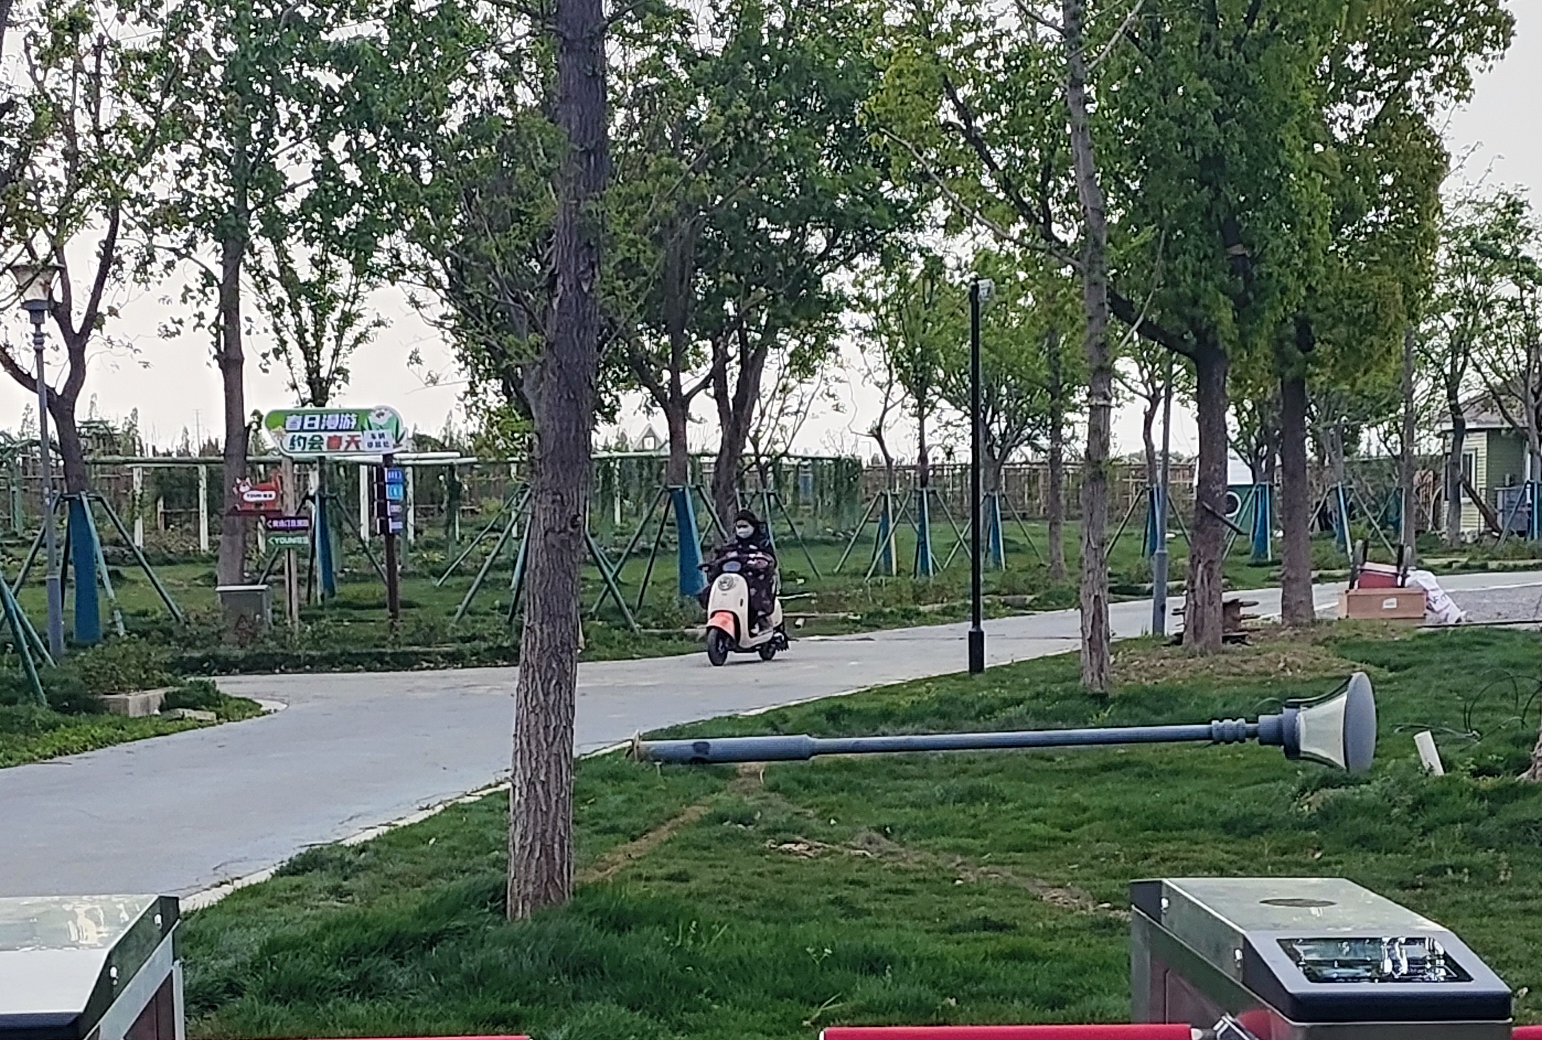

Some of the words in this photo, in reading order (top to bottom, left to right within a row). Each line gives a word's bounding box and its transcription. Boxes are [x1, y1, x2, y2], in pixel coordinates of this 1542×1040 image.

[285, 413, 357, 430] 春日漫游
[288, 434, 361, 450] 约会春天
